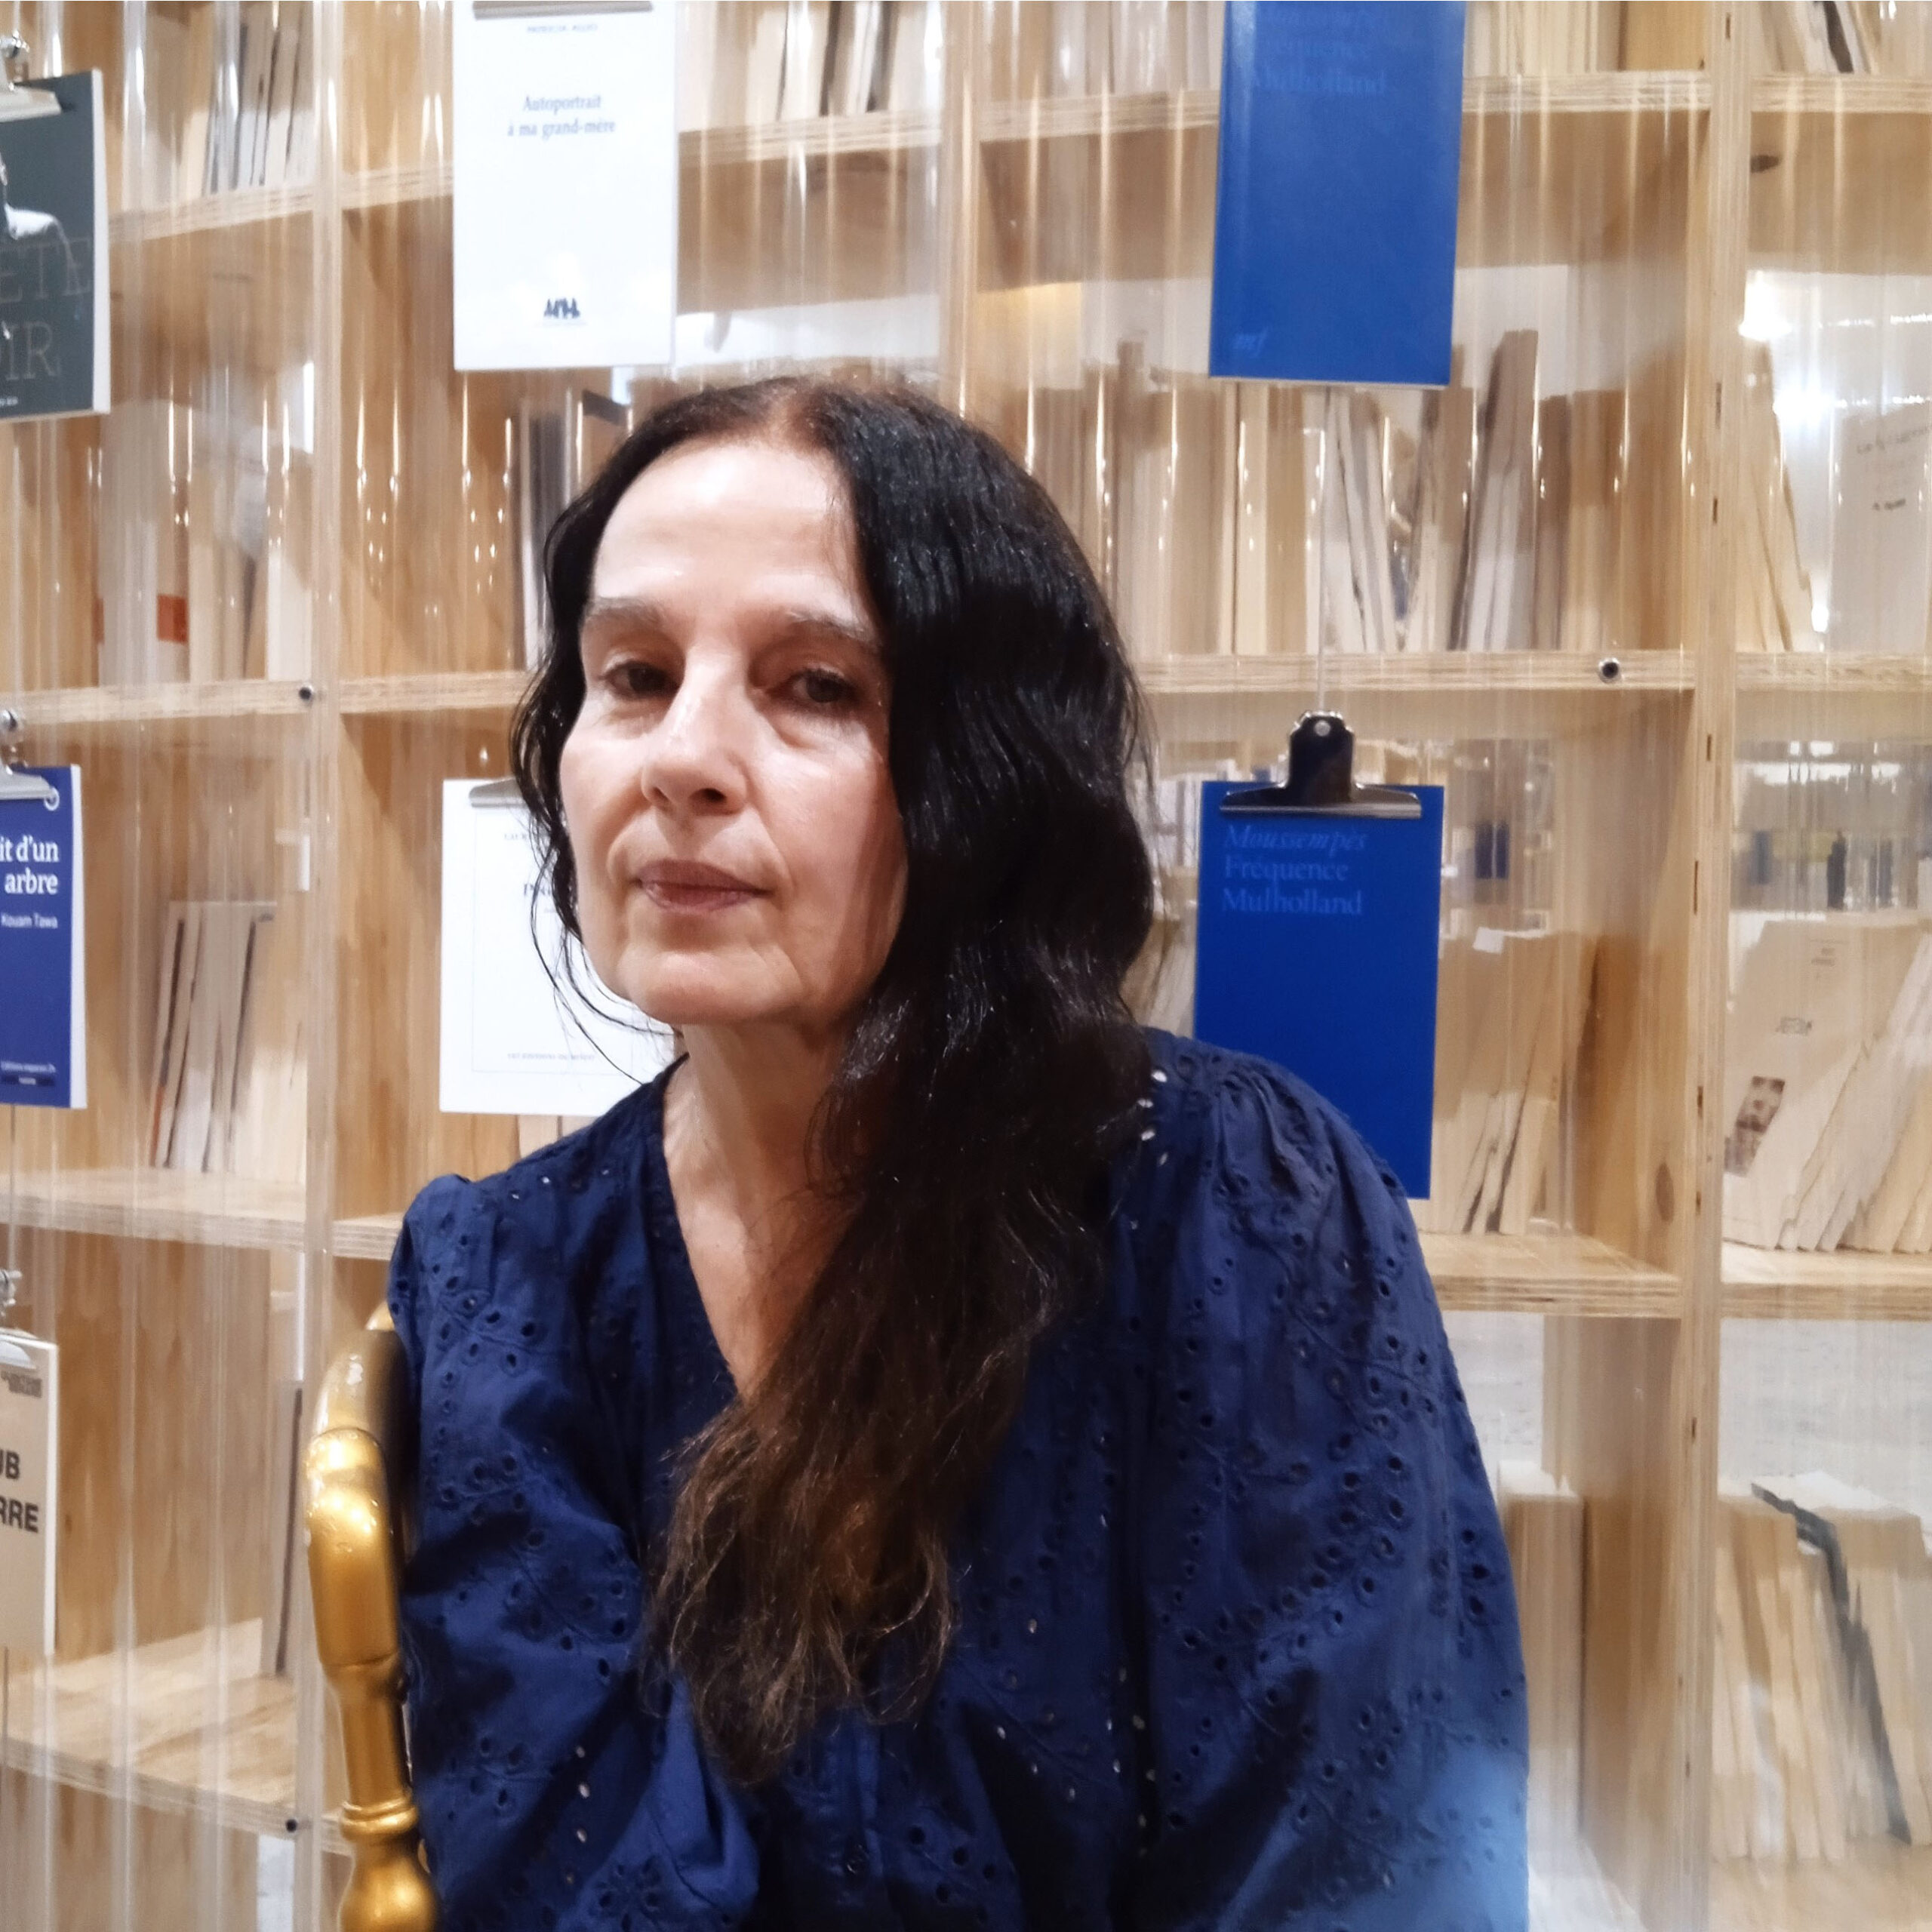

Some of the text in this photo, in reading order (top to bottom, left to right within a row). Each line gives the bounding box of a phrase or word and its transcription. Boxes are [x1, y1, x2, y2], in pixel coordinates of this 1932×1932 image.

[521, 95, 602, 115] Autoportrait
[518, 125, 537, 136] ma
[542, 118, 616, 141] grand-mère
[0, 320, 61, 380] IR
[16, 835, 60, 862] d'un
[5, 867, 59, 894] arbre
[1223, 888, 1361, 915] Mulholland
